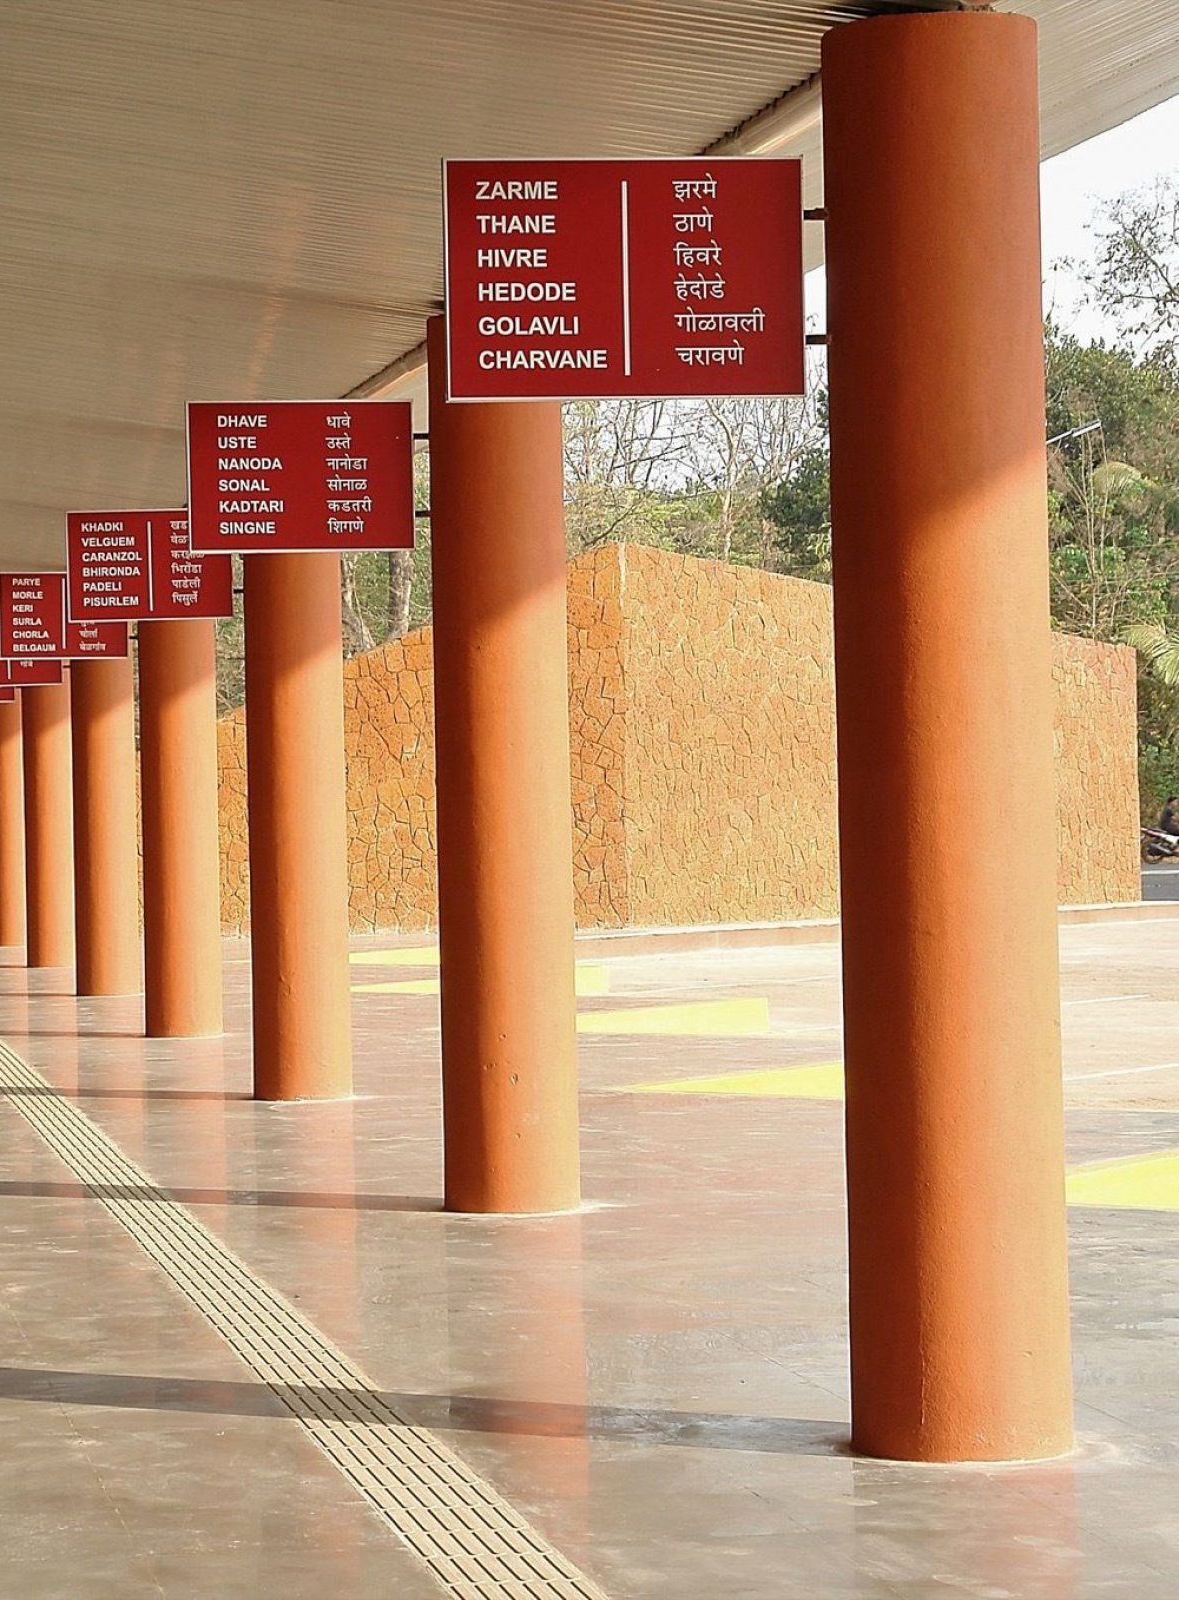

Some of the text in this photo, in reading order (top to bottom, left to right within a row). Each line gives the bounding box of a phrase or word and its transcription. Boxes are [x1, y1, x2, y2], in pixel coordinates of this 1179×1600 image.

[476, 181, 558, 200] ZARME
[672, 173, 718, 203] झरमे
[476, 215, 556, 234] THANE
[673, 206, 714, 233] ठाणे
[477, 249, 548, 268] HIVRE
[673, 240, 722, 268] हिवरे
[478, 283, 576, 302] HEDODE
[674, 273, 725, 301] हेदोडे
[674, 307, 765, 333] गोळावली
[478, 317, 579, 336] GOLAVLI
[675, 339, 745, 366] चरावणे
[479, 350, 608, 370] CHARVANE
[218, 415, 267, 427] DHAVE
[326, 412, 351, 428] धावे
[218, 437, 256, 449] USTE
[325, 433, 351, 449] उस्ते
[218, 458, 282, 470] NANODA
[326, 454, 368, 470] नानोडा
[219, 480, 269, 492] SONAL
[326, 474, 368, 491] सोनाळ
[220, 501, 283, 513] KADTARI
[327, 496, 372, 512] कडतरी
[81, 522, 123, 532] KHADKI
[220, 522, 276, 534] SINGNE
[81, 536, 134, 547] VELGUEM
[82, 552, 142, 562] CARANZOL
[82, 567, 141, 577] BHIRONDA
[12, 578, 41, 587] PARYE
[83, 582, 122, 592] PADELI
[12, 591, 44, 600] MORLE
[83, 596, 138, 607] PISURLEM
[12, 604, 34, 613] KERI
[12, 617, 42, 626] SURLA
[12, 630, 50, 639] CHORLA
[12, 643, 56, 652] BELGAUM
